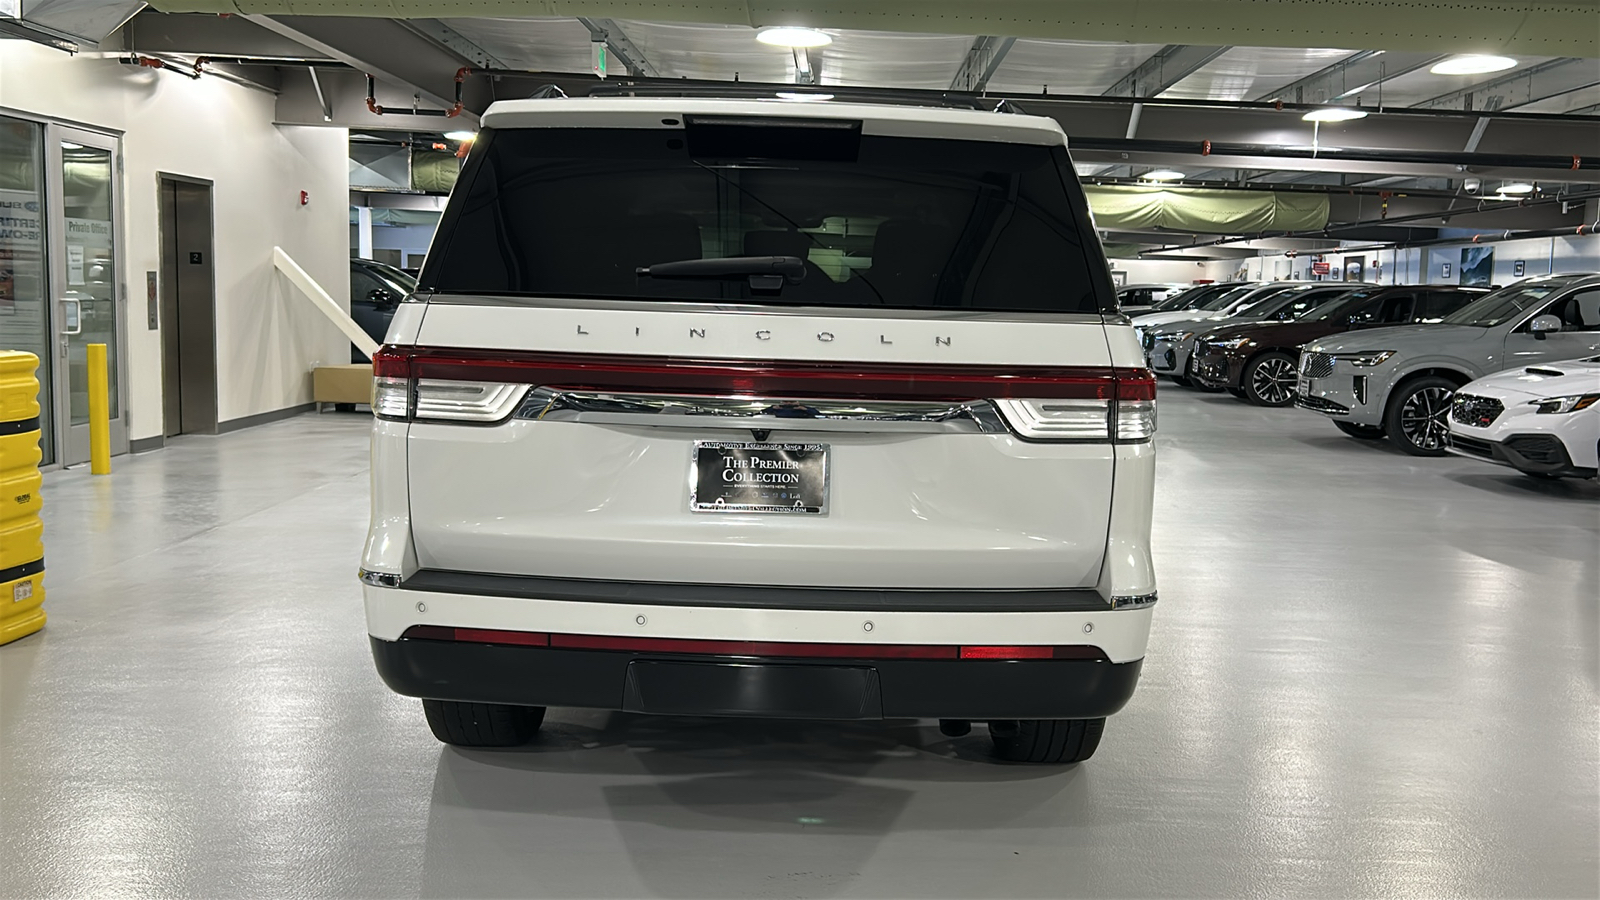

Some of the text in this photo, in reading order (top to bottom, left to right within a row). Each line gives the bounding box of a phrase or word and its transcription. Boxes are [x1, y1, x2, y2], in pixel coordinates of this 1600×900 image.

[68, 221, 108, 235] Private Office
[576, 324, 951, 347] LINCOLN
[723, 456, 799, 469] THE PREMIER
[722, 469, 799, 483] COLLECTION
